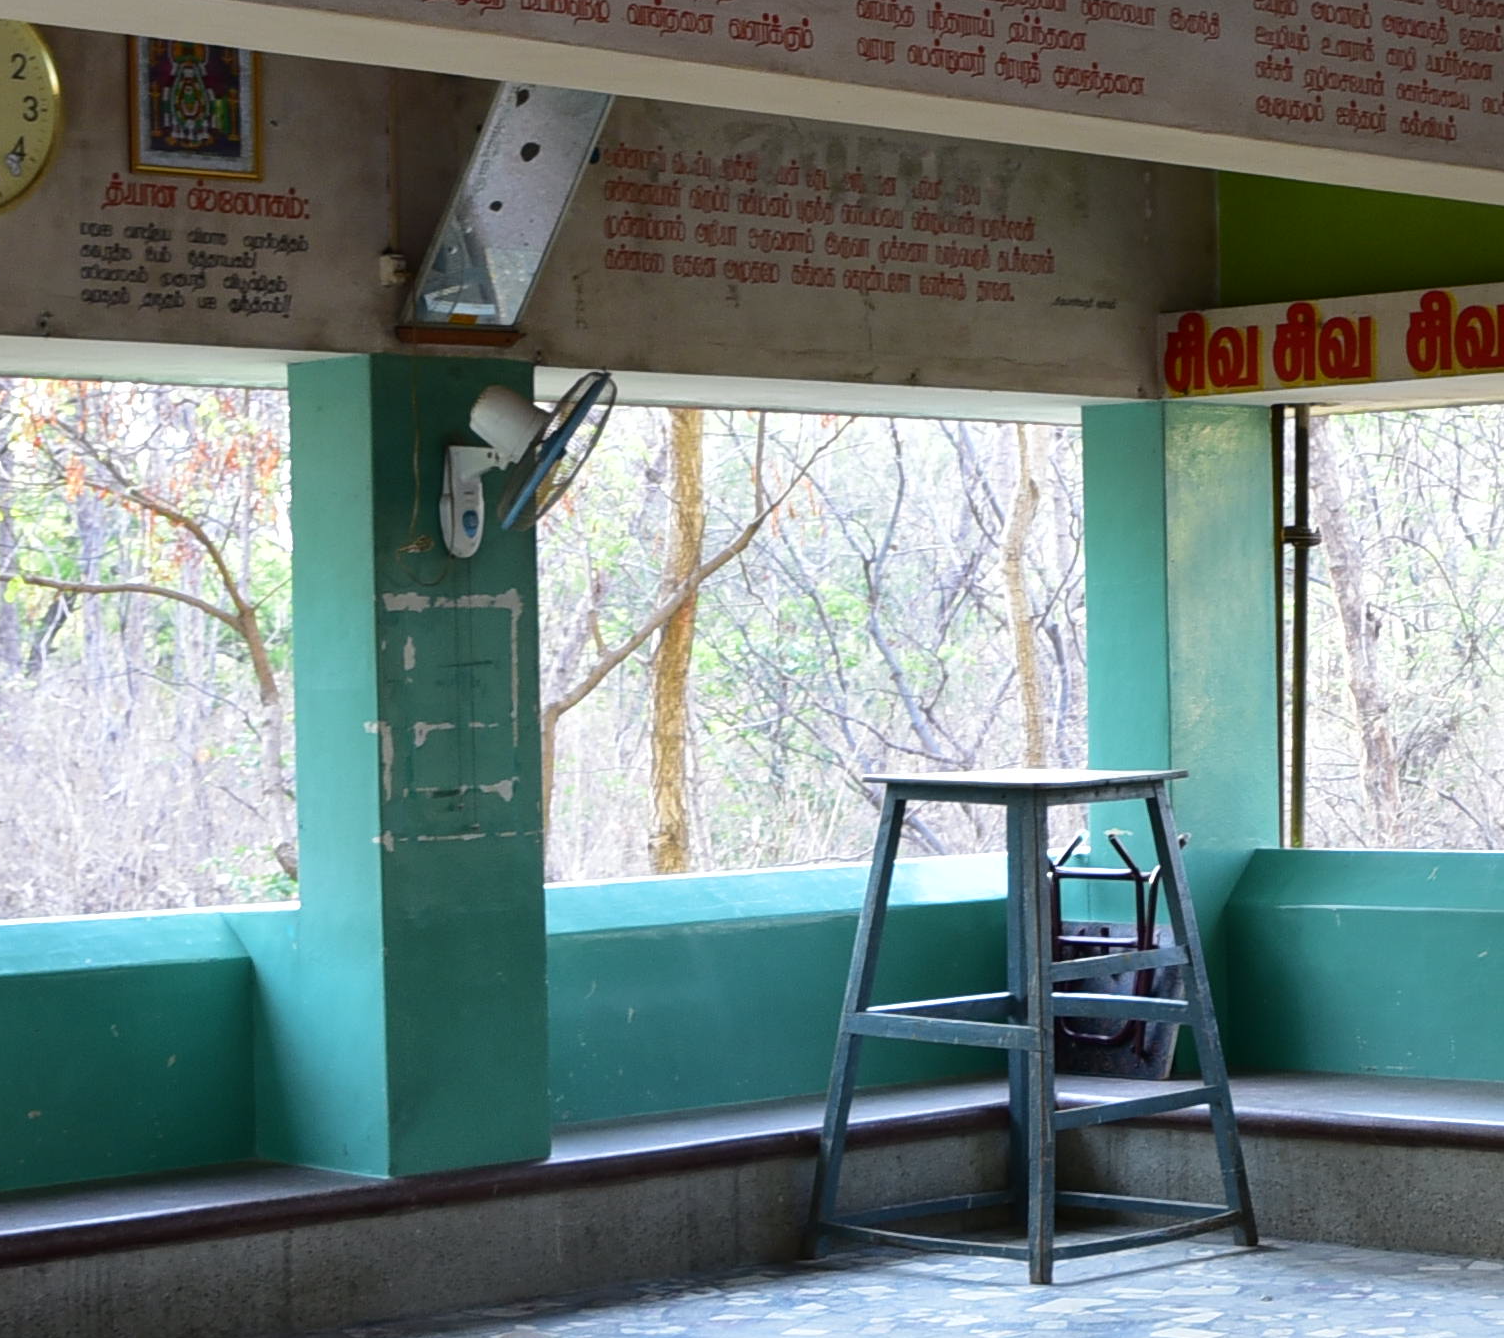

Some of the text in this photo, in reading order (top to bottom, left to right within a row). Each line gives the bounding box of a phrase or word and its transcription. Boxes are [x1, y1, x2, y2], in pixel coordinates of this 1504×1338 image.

[11, 53, 27, 80] 2
[22, 96, 39, 122] 3
[101, 172, 179, 210] த்யான
[1167, 316, 1260, 391] சிவ
[1274, 303, 1373, 382] சிவ
